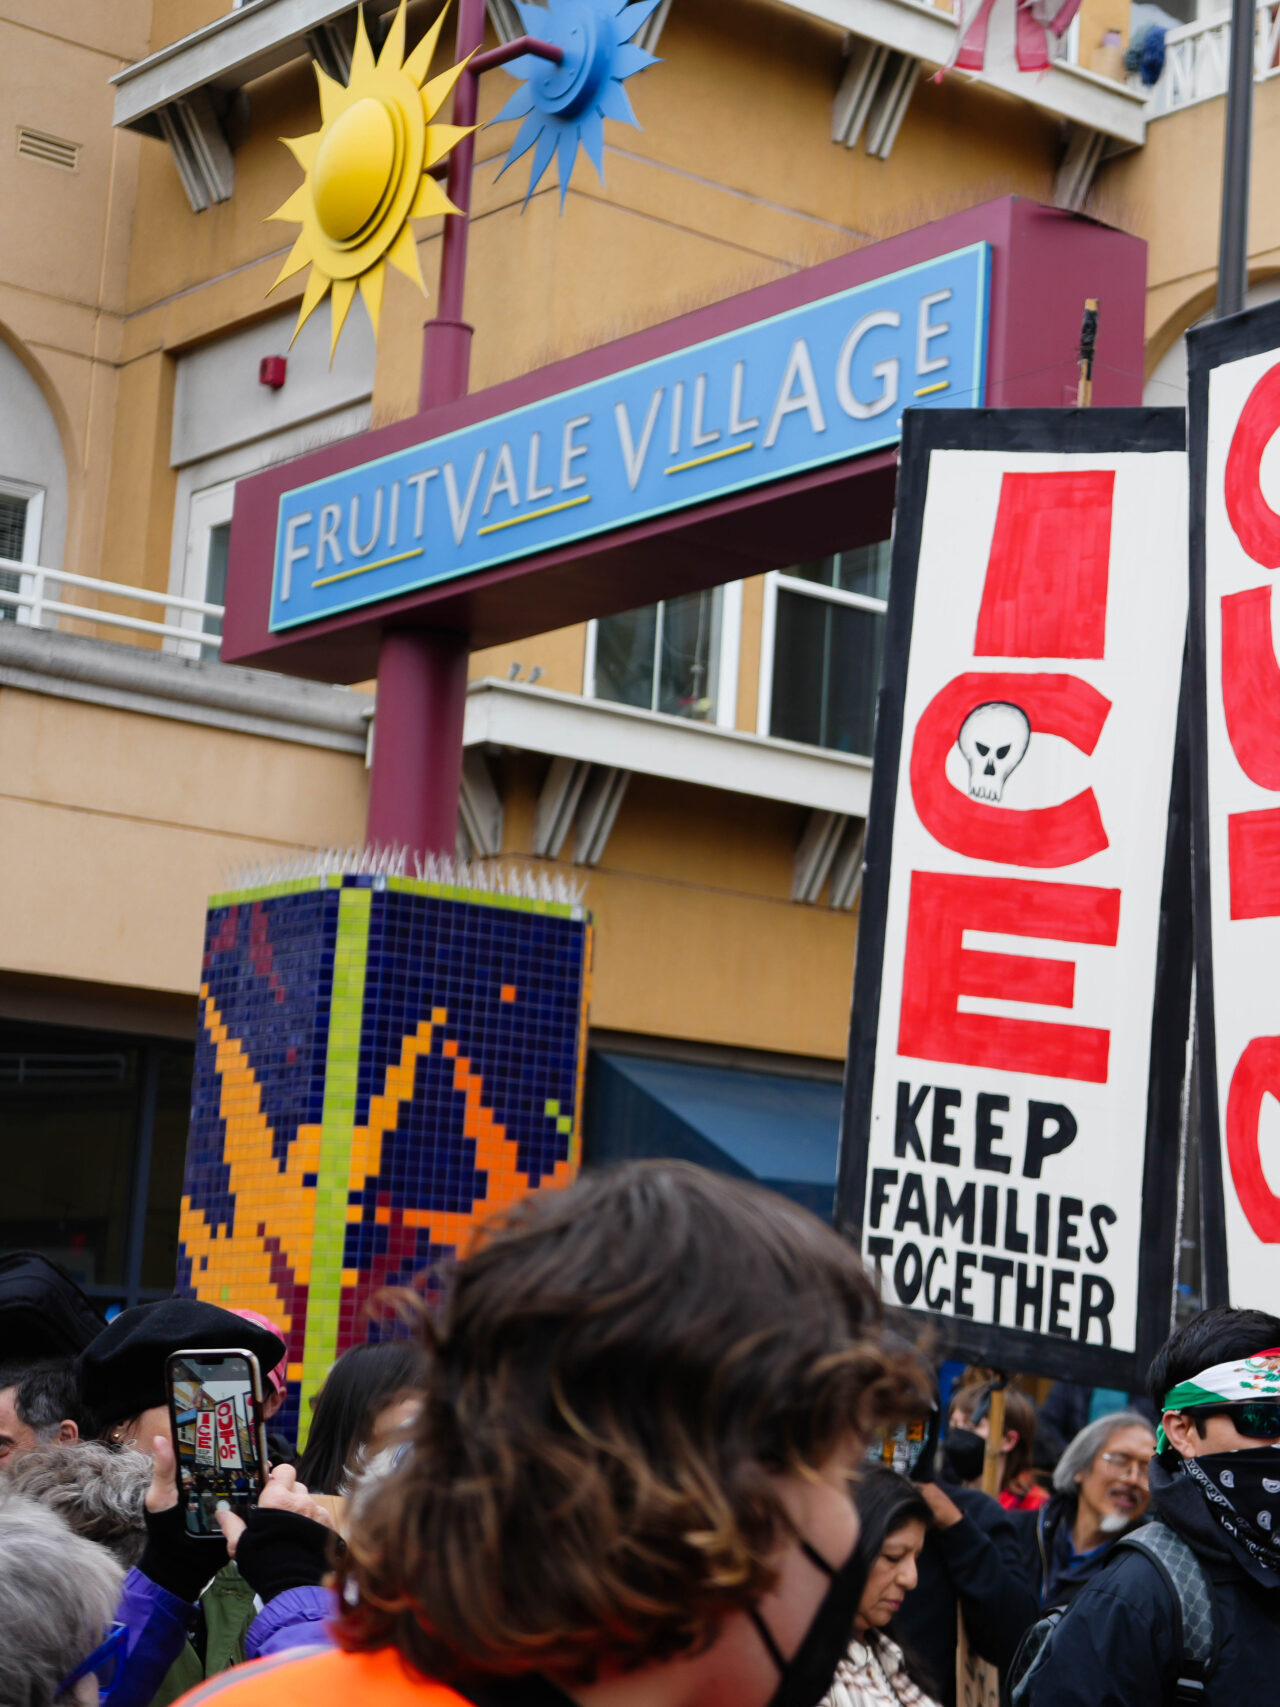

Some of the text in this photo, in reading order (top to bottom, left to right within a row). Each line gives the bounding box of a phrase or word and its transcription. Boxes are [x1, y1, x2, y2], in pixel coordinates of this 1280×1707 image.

[280, 287, 954, 602] FRUITVALE VILLAGE
[896, 469, 1122, 1084] ICE
[894, 1080, 1078, 1179] KEEP
[869, 1168, 1118, 1263] FAMILIES
[867, 1235, 1115, 1348] TOGETHER
